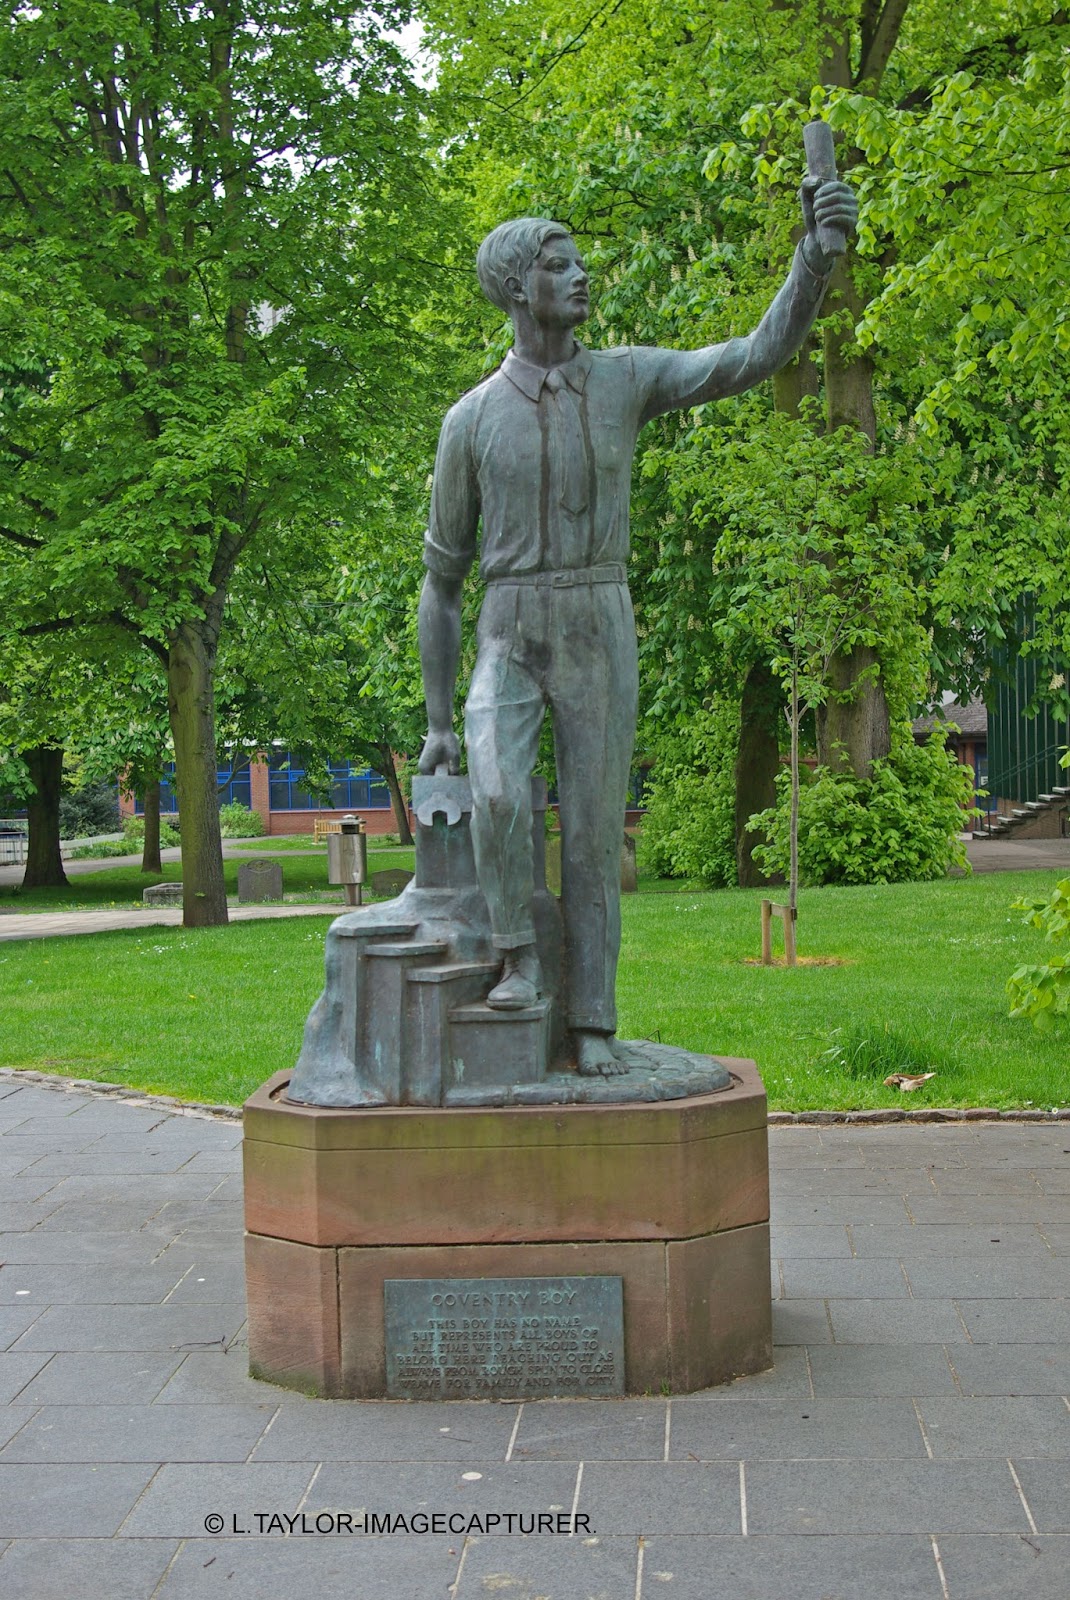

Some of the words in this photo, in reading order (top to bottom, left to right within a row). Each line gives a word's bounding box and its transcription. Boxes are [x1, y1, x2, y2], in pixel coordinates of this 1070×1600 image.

[432, 1293, 529, 1307] COVENTRY
[539, 1291, 577, 1305] BOY
[428, 1319, 457, 1330] THIS
[463, 1319, 488, 1329] BOY
[494, 1319, 517, 1328] HAS
[522, 1318, 539, 1328] NO
[545, 1317, 581, 1327] NAME
[412, 1331, 435, 1341] BUT
[441, 1331, 515, 1341] REPRESENTS
[520, 1330, 542, 1339] ALL
[547, 1329, 577, 1339] BOYS
[583, 1328, 599, 1338] OF
[413, 1343, 435, 1353] ALL
[439, 1343, 469, 1353] TIME
[473, 1342, 502, 1352] WHO
[507, 1342, 532, 1352] ARE
[536, 1341, 579, 1351] PROUD
[583, 1340, 598, 1350] TO
[397, 1355, 448, 1365] BELONG
[453, 1354, 486, 1364] HERE
[493, 1353, 560, 1364] REACHING
[567, 1352, 593, 1362] OUT
[598, 1351, 613, 1361] AS
[398, 1367, 441, 1377] ALWAYS
[445, 1366, 477, 1377] FROM
[482, 1365, 522, 1376] ROUGH
[529, 1365, 559, 1375] SPUN
[561, 1365, 576, 1374] TO
[580, 1364, 615, 1373] CLOSE
[447, 1378, 471, 1389] FOR
[525, 1377, 551, 1387] AND
[556, 1377, 580, 1386] FOR
